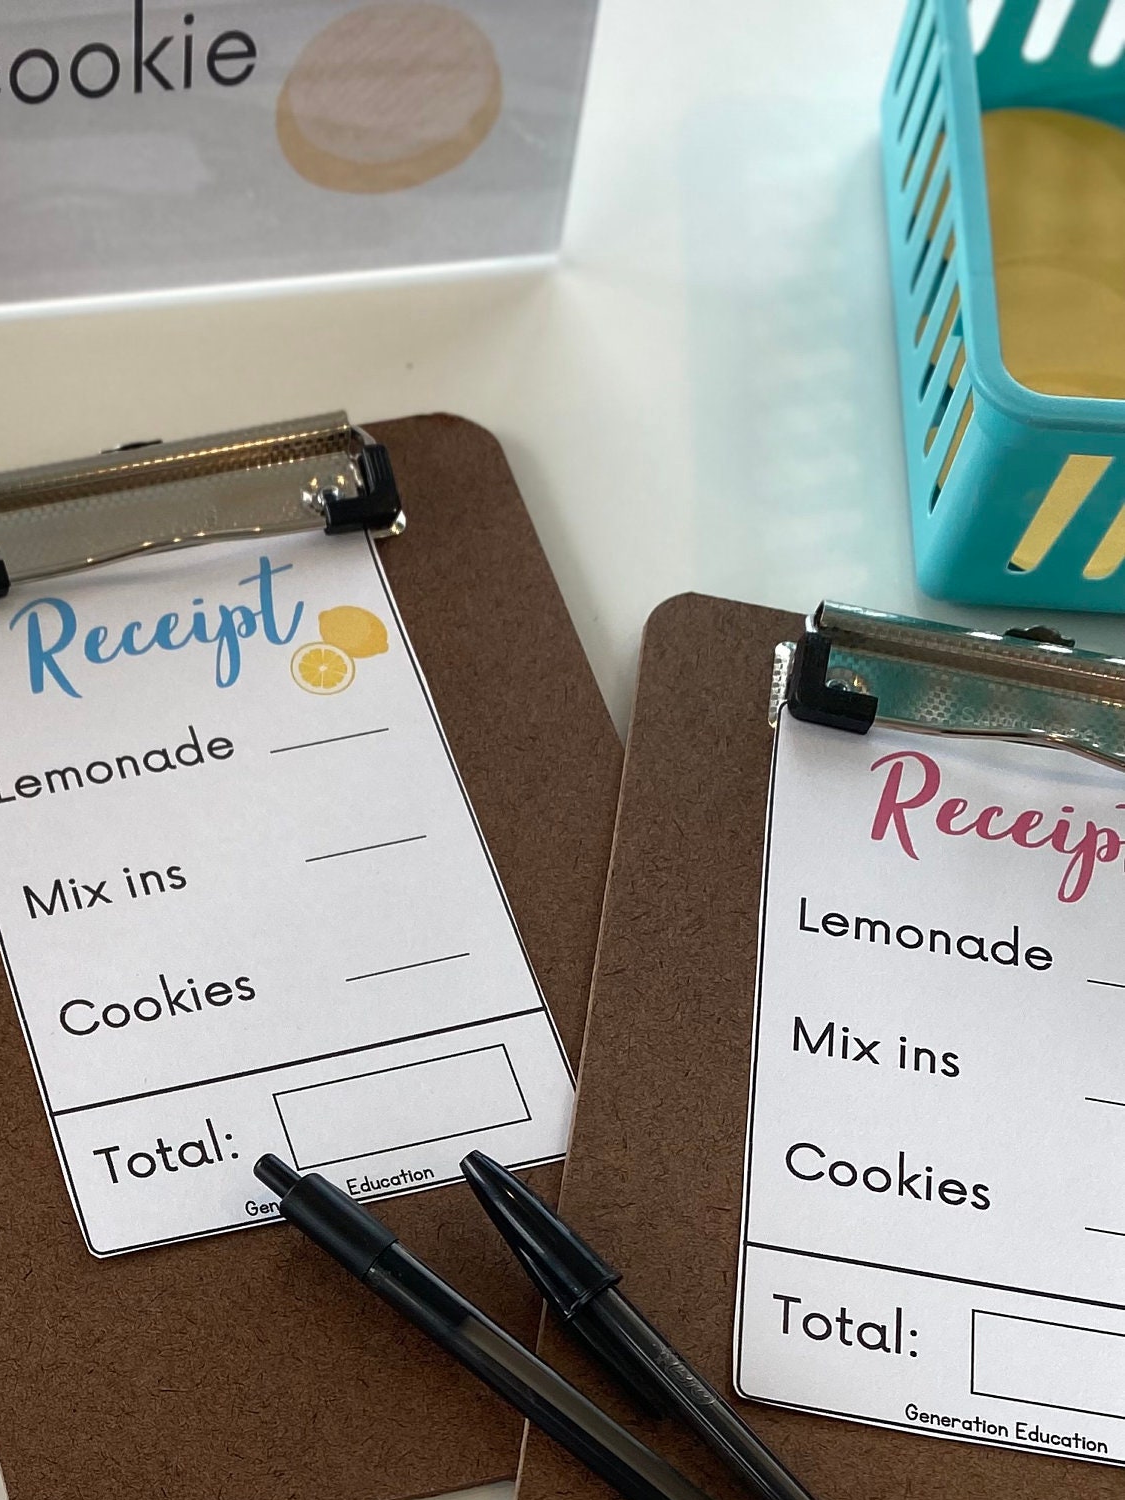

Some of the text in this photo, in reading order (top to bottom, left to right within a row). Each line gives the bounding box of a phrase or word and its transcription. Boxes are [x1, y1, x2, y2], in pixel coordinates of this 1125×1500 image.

[9, 555, 304, 698] Receipt
[870, 750, 1125, 903] Receip
[22, 865, 188, 920] Mix ins
[799, 896, 1053, 971] Lemonade
[59, 973, 256, 1037] Cookies
[792, 1015, 960, 1078] Mix ins
[92, 1117, 239, 1184] Total:
[346, 1167, 435, 1196] Education
[785, 1142, 991, 1211] Cookies
[772, 1293, 918, 1358] Total:
[904, 1403, 1109, 1454] Generation Education
